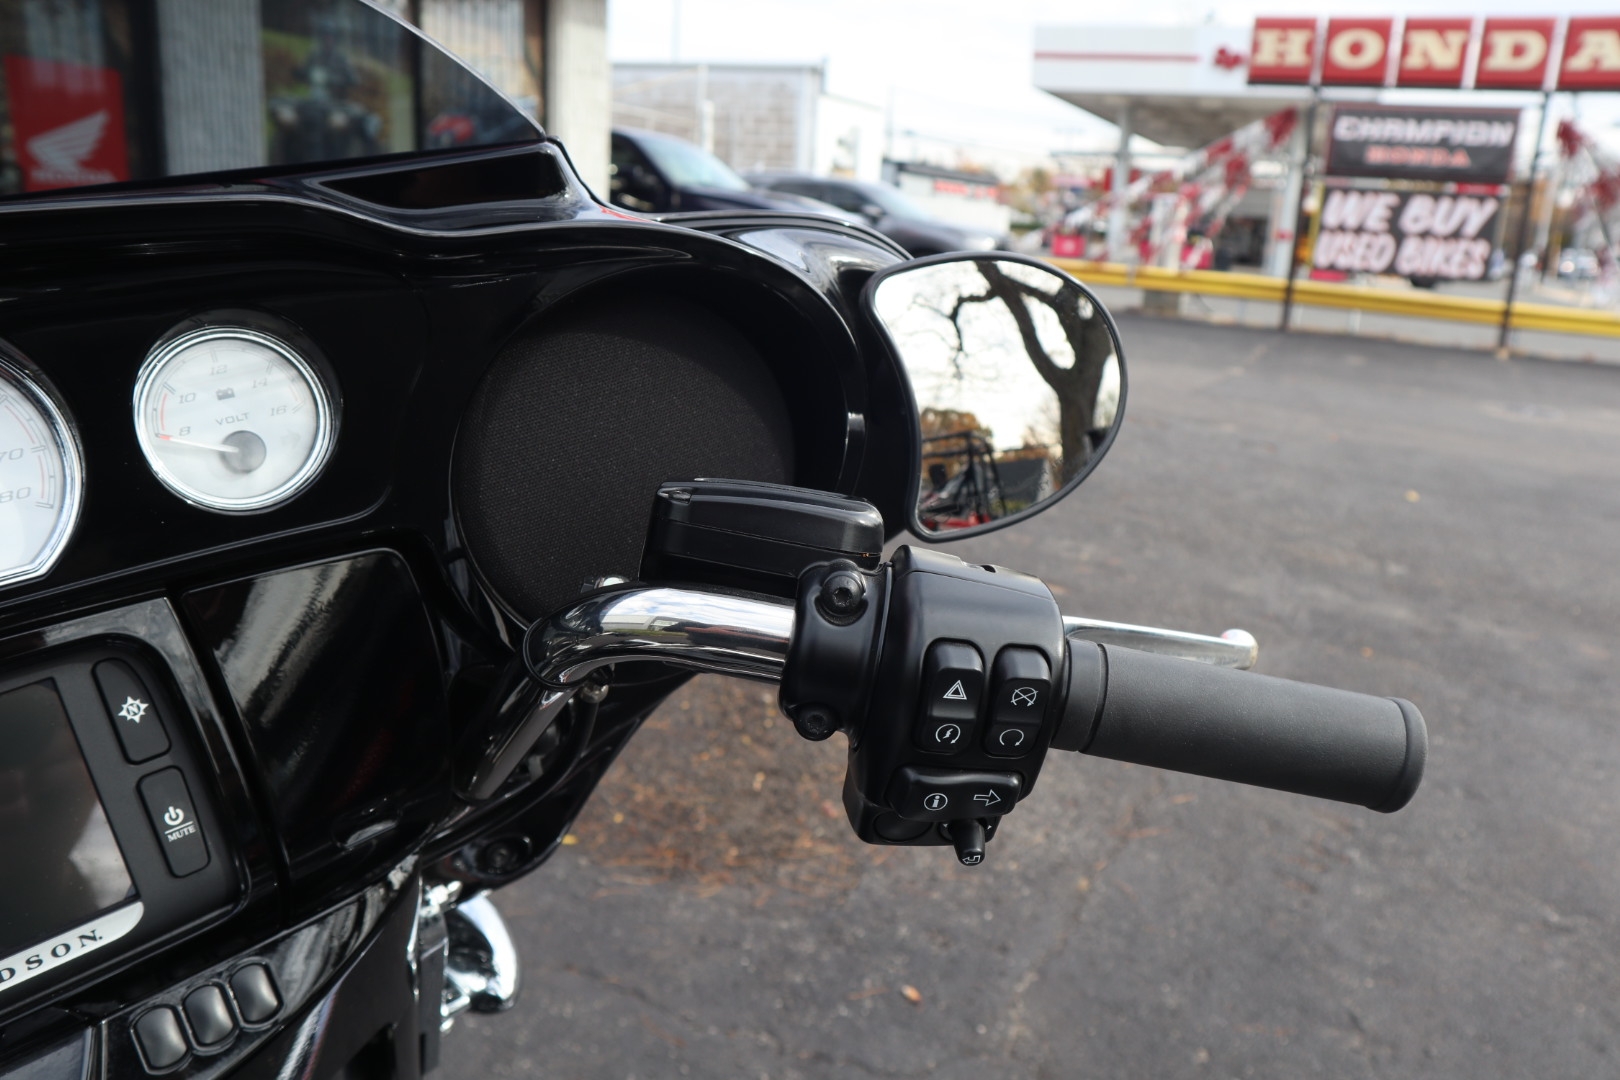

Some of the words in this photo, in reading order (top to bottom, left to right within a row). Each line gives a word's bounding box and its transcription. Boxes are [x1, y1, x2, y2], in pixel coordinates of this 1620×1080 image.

[1252, 27, 1620, 72] HONDA
[1333, 115, 1516, 147] CHAMPION
[1364, 144, 1472, 167] HONDA
[1322, 189, 1401, 233] WE
[1399, 193, 1500, 239] BUY
[1313, 229, 1397, 273] USED
[1395, 234, 1492, 280] BIKES
[208, 364, 229, 377] 12
[251, 377, 269, 389] 14
[178, 392, 197, 405] 10
[215, 411, 251, 426] VOLT
[269, 404, 288, 417] 16
[178, 425, 192, 437] 8
[167, 824, 197, 843] MUTE
